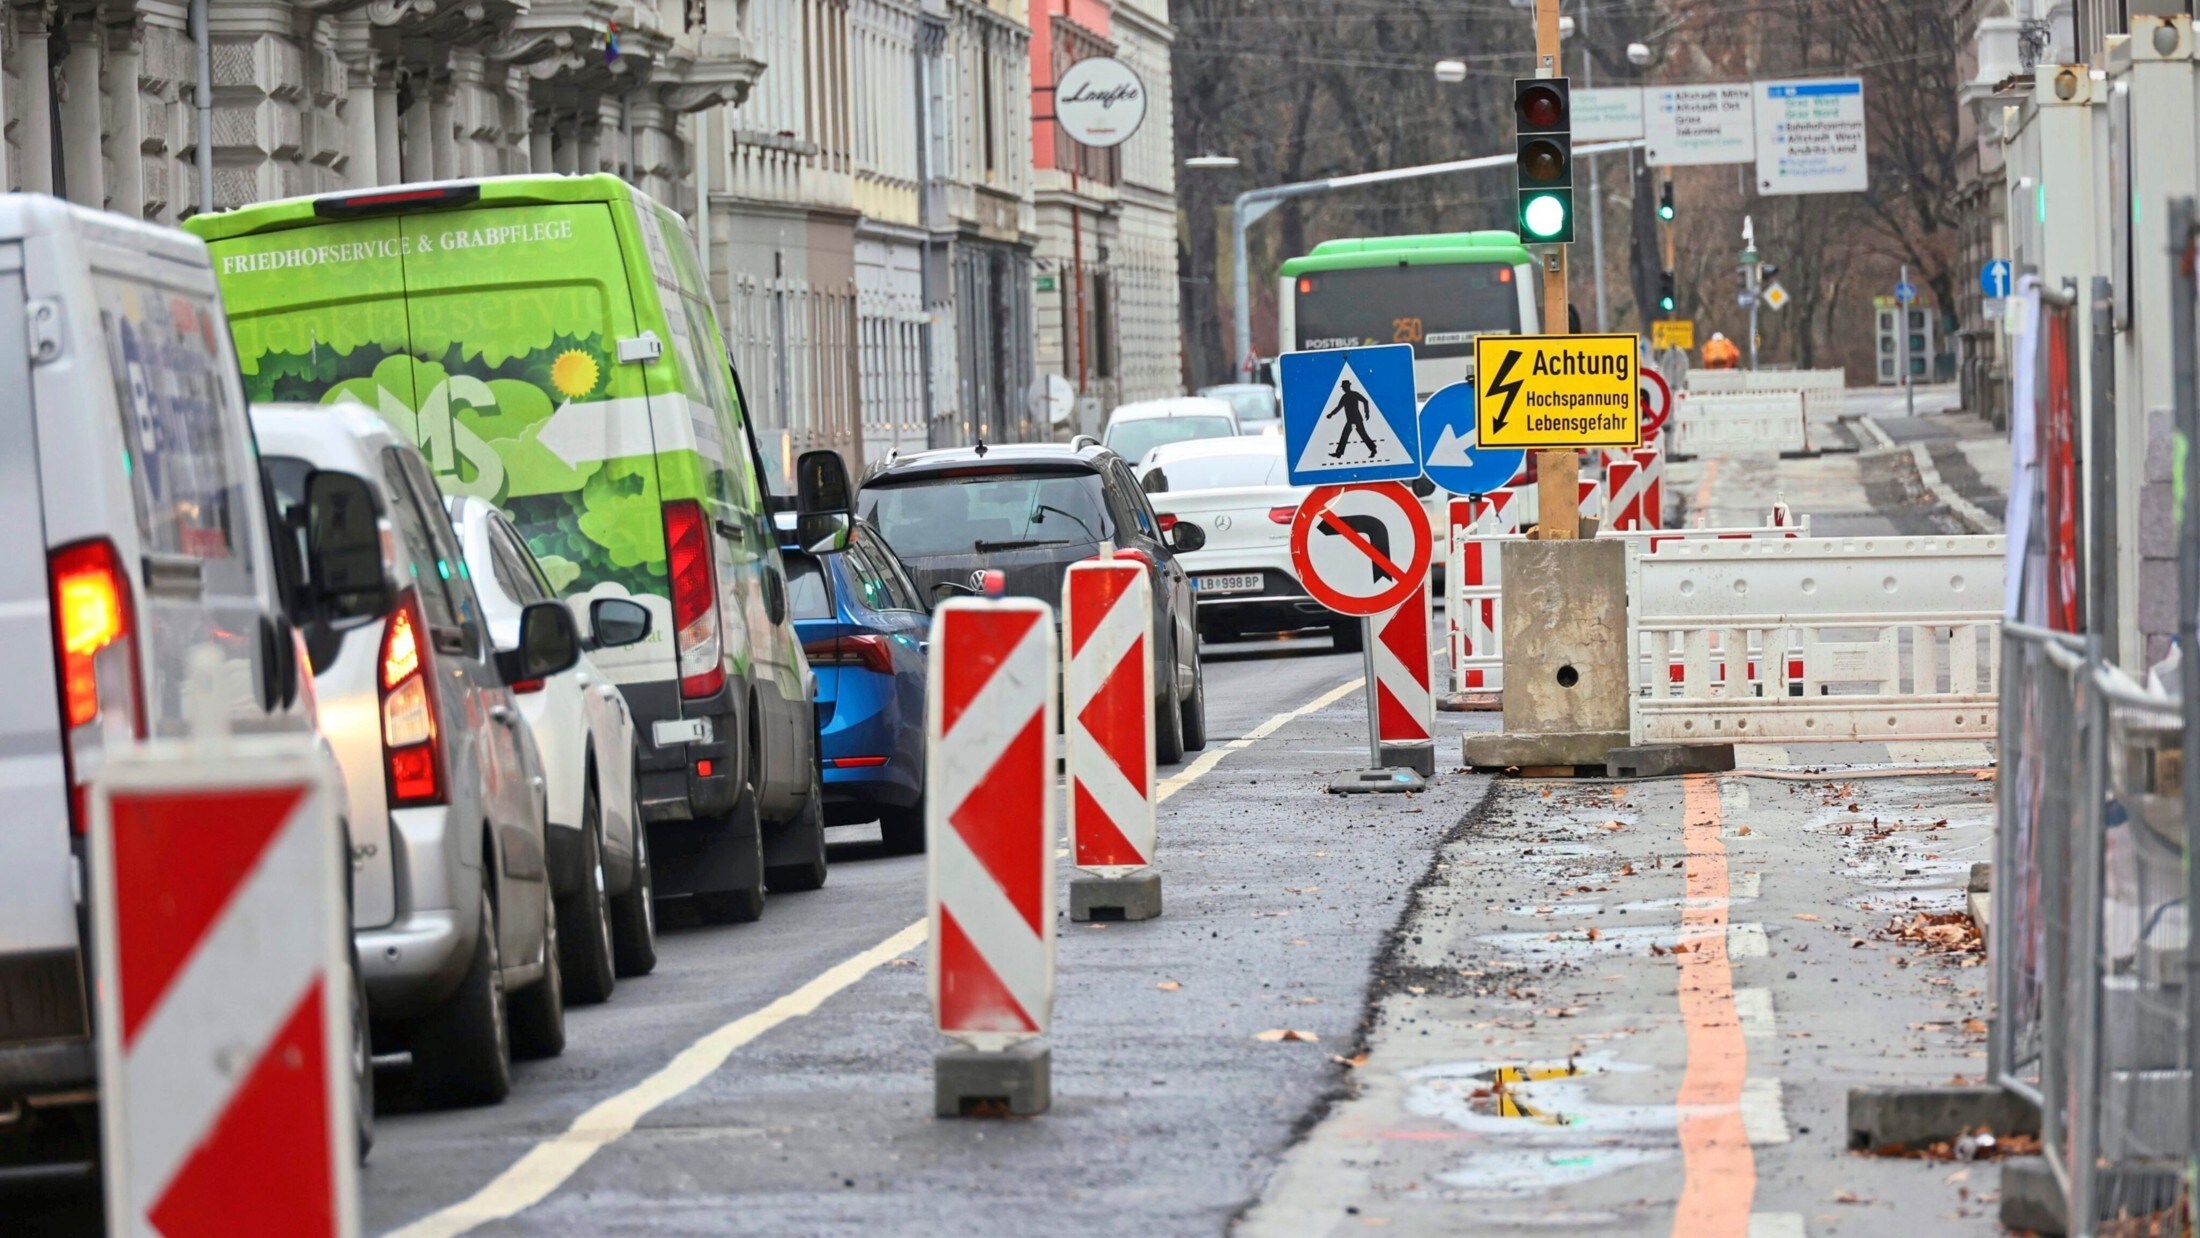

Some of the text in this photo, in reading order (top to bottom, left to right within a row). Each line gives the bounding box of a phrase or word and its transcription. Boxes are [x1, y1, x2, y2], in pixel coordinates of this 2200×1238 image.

[222, 220, 573, 275] FRIEDHOFSERVICE & GRABPFLEGE
[1392, 317, 1423, 343] 250
[1305, 337, 1360, 349] POSTBUS
[1532, 349, 1628, 381] Achtung
[1526, 391, 1629, 410] Hochspannung
[1527, 413, 1628, 435] Lebensgefahr
[1221, 577, 1243, 589] 998
[1244, 575, 1260, 588] BP
